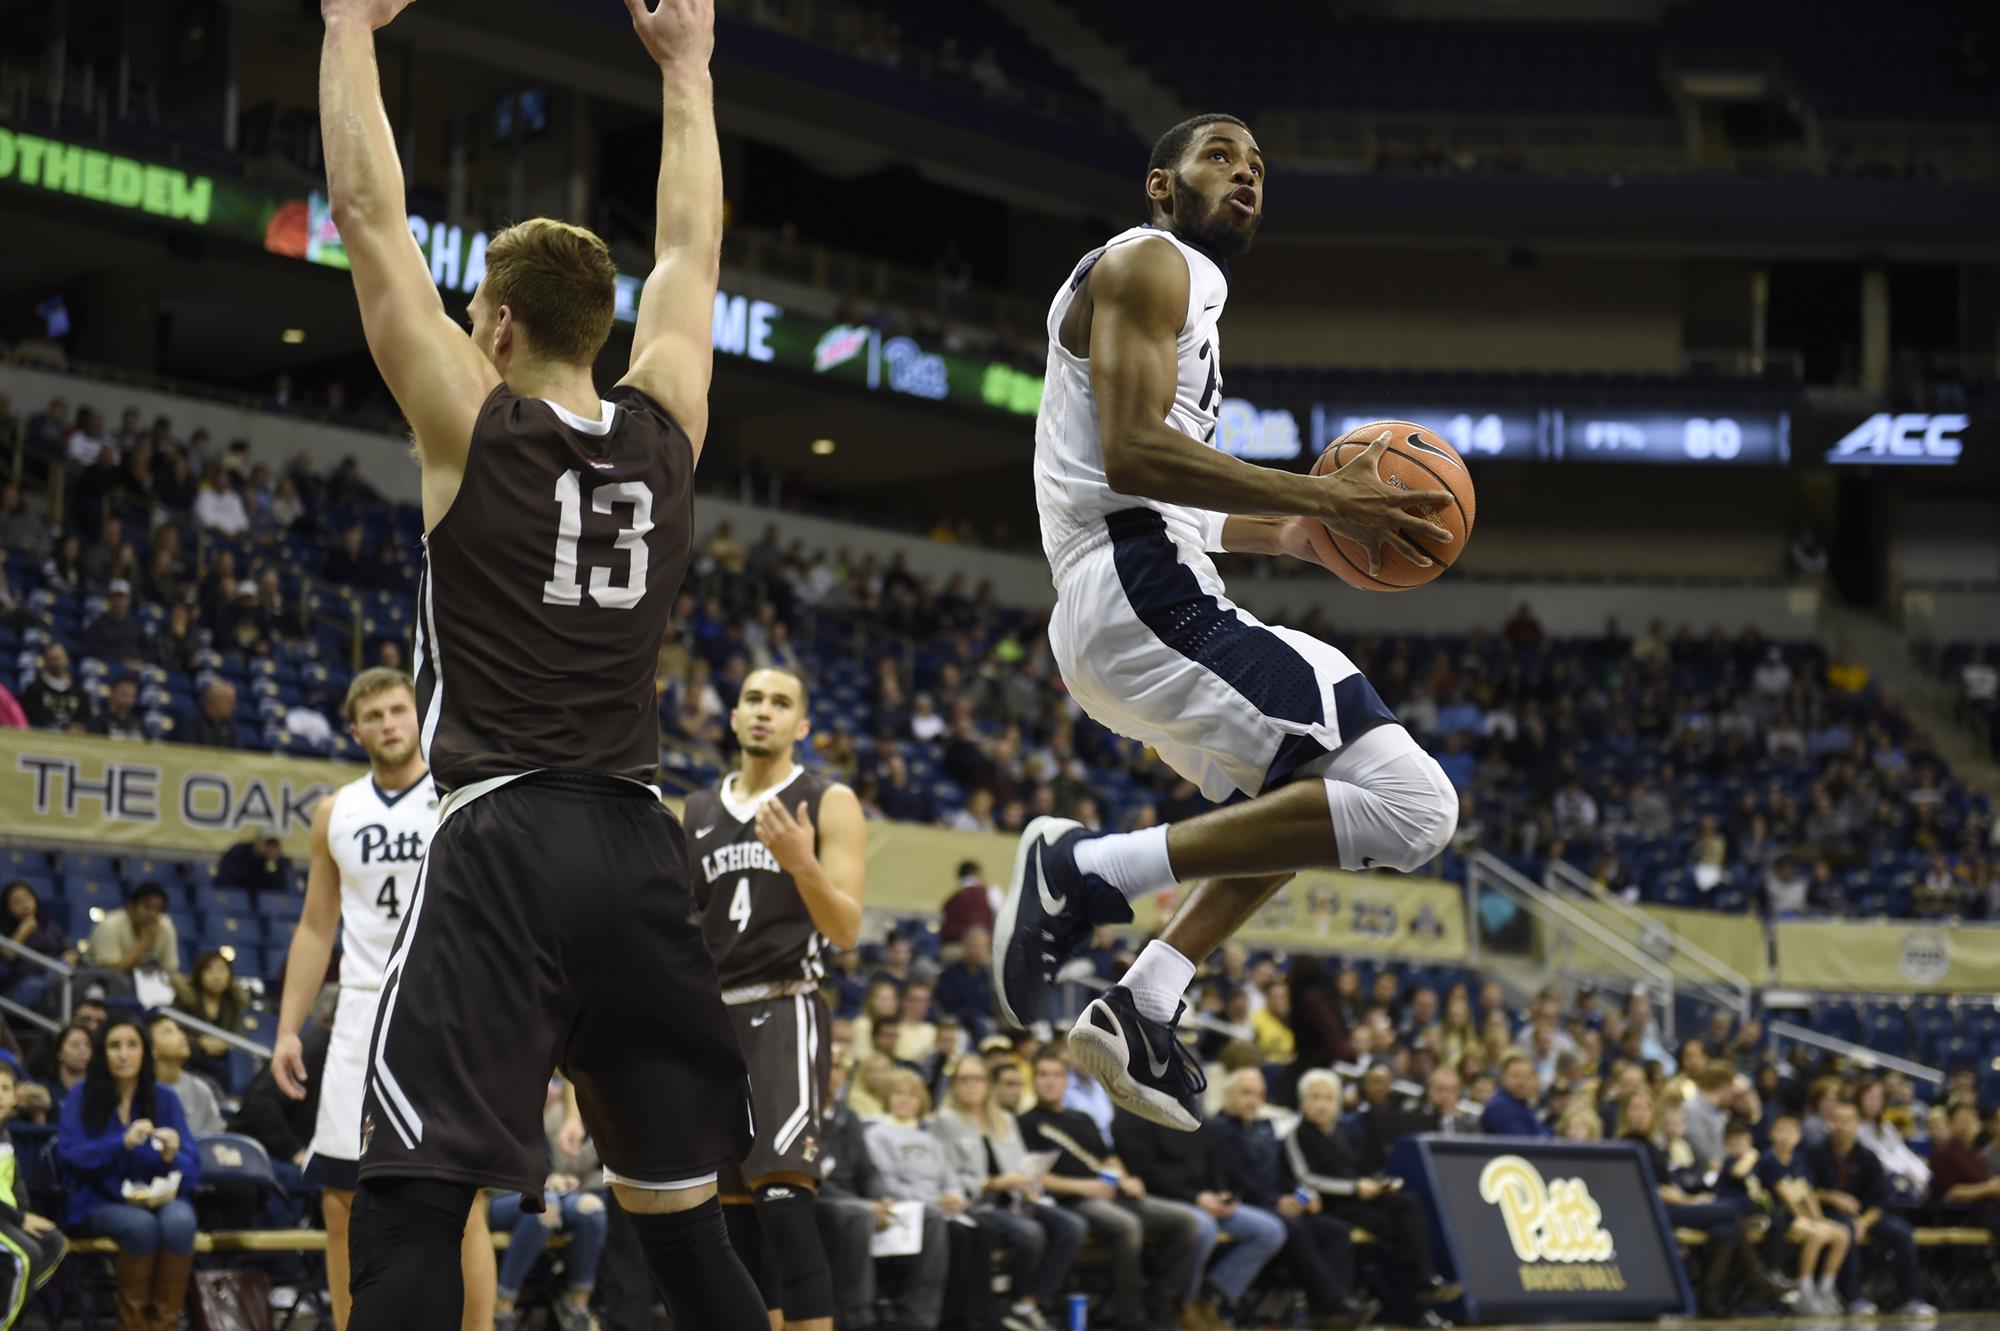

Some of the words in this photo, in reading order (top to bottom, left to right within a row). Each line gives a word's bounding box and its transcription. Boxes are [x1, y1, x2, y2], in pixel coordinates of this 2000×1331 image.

[1827, 412, 1969, 464] ACC
[543, 469, 655, 609] 13
[17, 754, 162, 823] THE
[353, 823, 426, 864] Pitt
[376, 876, 399, 919] 4
[729, 876, 752, 933] 4
[1479, 1154, 1614, 1263] Pitt
